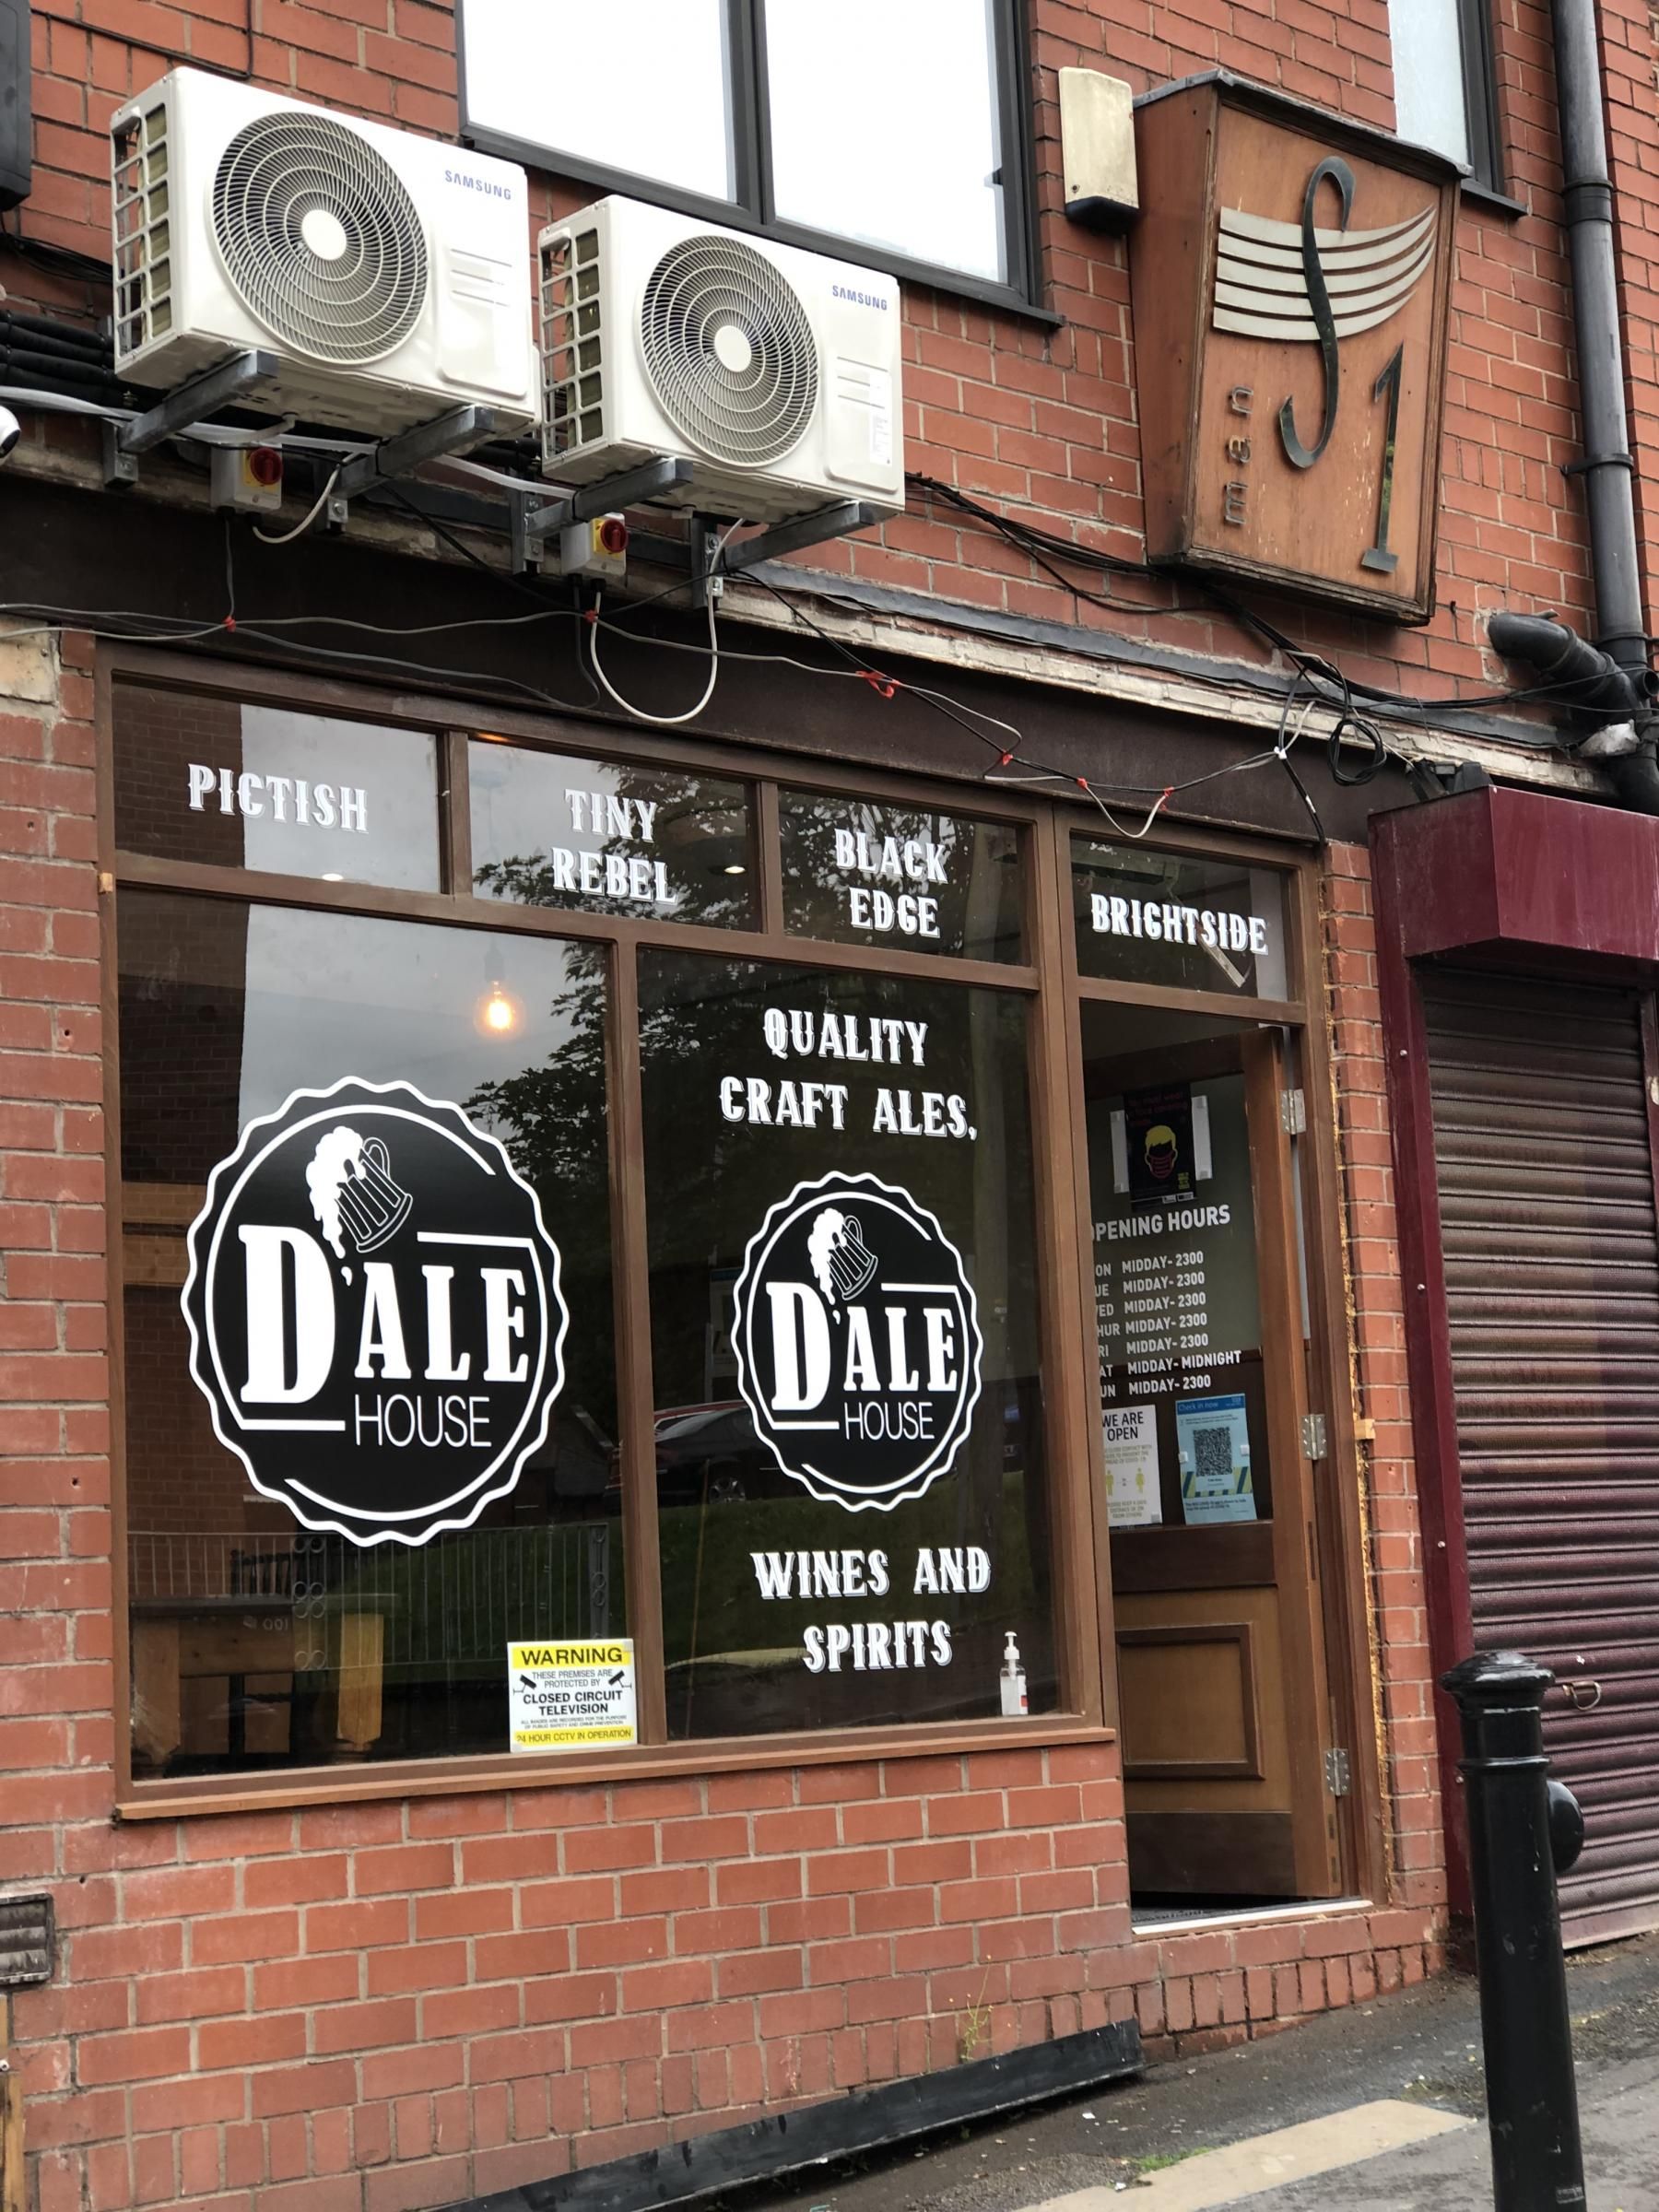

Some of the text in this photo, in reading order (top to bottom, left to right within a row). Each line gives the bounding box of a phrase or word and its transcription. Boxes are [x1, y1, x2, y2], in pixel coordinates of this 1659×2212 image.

[444, 170, 512, 200] SAMSUNG
[832, 285, 887, 311] SAMSUNG
[187, 763, 369, 833] PICTISH
[564, 788, 658, 843] TINY
[834, 828, 948, 884] BLACK
[550, 847, 678, 905] REBEL
[849, 887, 941, 938] EDGE
[1090, 893, 1269, 956] BRIGHTSIDE
[762, 1006, 928, 1066] QUALITY
[719, 1076, 978, 1141] CRAFT ALES,
[1091, 1205, 1230, 1241] PENING HOURS
[1095, 1263, 1112, 1277] ON
[1175, 1251, 1204, 1266] 2300
[1094, 1284, 1109, 1297] UE
[1177, 1271, 1205, 1288] 2300
[238, 1224, 529, 1404] D'ALE
[1095, 1303, 1114, 1317] ED
[1178, 1291, 1206, 1308] 2300
[1097, 1324, 1120, 1337] HUR
[1179, 1312, 1207, 1328] 2300
[766, 1281, 958, 1412] D'ALE
[1098, 1345, 1109, 1358] RI
[1180, 1333, 1209, 1348] 2300
[1099, 1365, 1113, 1378] AT
[1181, 1350, 1241, 1370] MIDNIGHT
[1100, 1384, 1116, 1398] UN
[1182, 1374, 1211, 1390] 2300
[355, 1394, 492, 1448] HOUSE
[844, 1401, 935, 1441] HOUSE
[1102, 1411, 1144, 1428] WE ARE
[1107, 1426, 1138, 1441] OPEN
[749, 1546, 992, 1600] WINES AND
[521, 1647, 622, 1665] WARNING
[802, 1619, 953, 1674] SPIRITS
[532, 1668, 613, 1680] THESE PREMISES ARE
[544, 1678, 600, 1688] PROTECTED BY
[523, 1690, 622, 1704] CLOSED CIRCUIT
[538, 1703, 608, 1716] TELEVISION
[528, 1734, 551, 1742] HOUR
[553, 1733, 575, 1741] CCTV
[577, 1732, 585, 1740] IN
[587, 1729, 631, 1739] OPERATION
